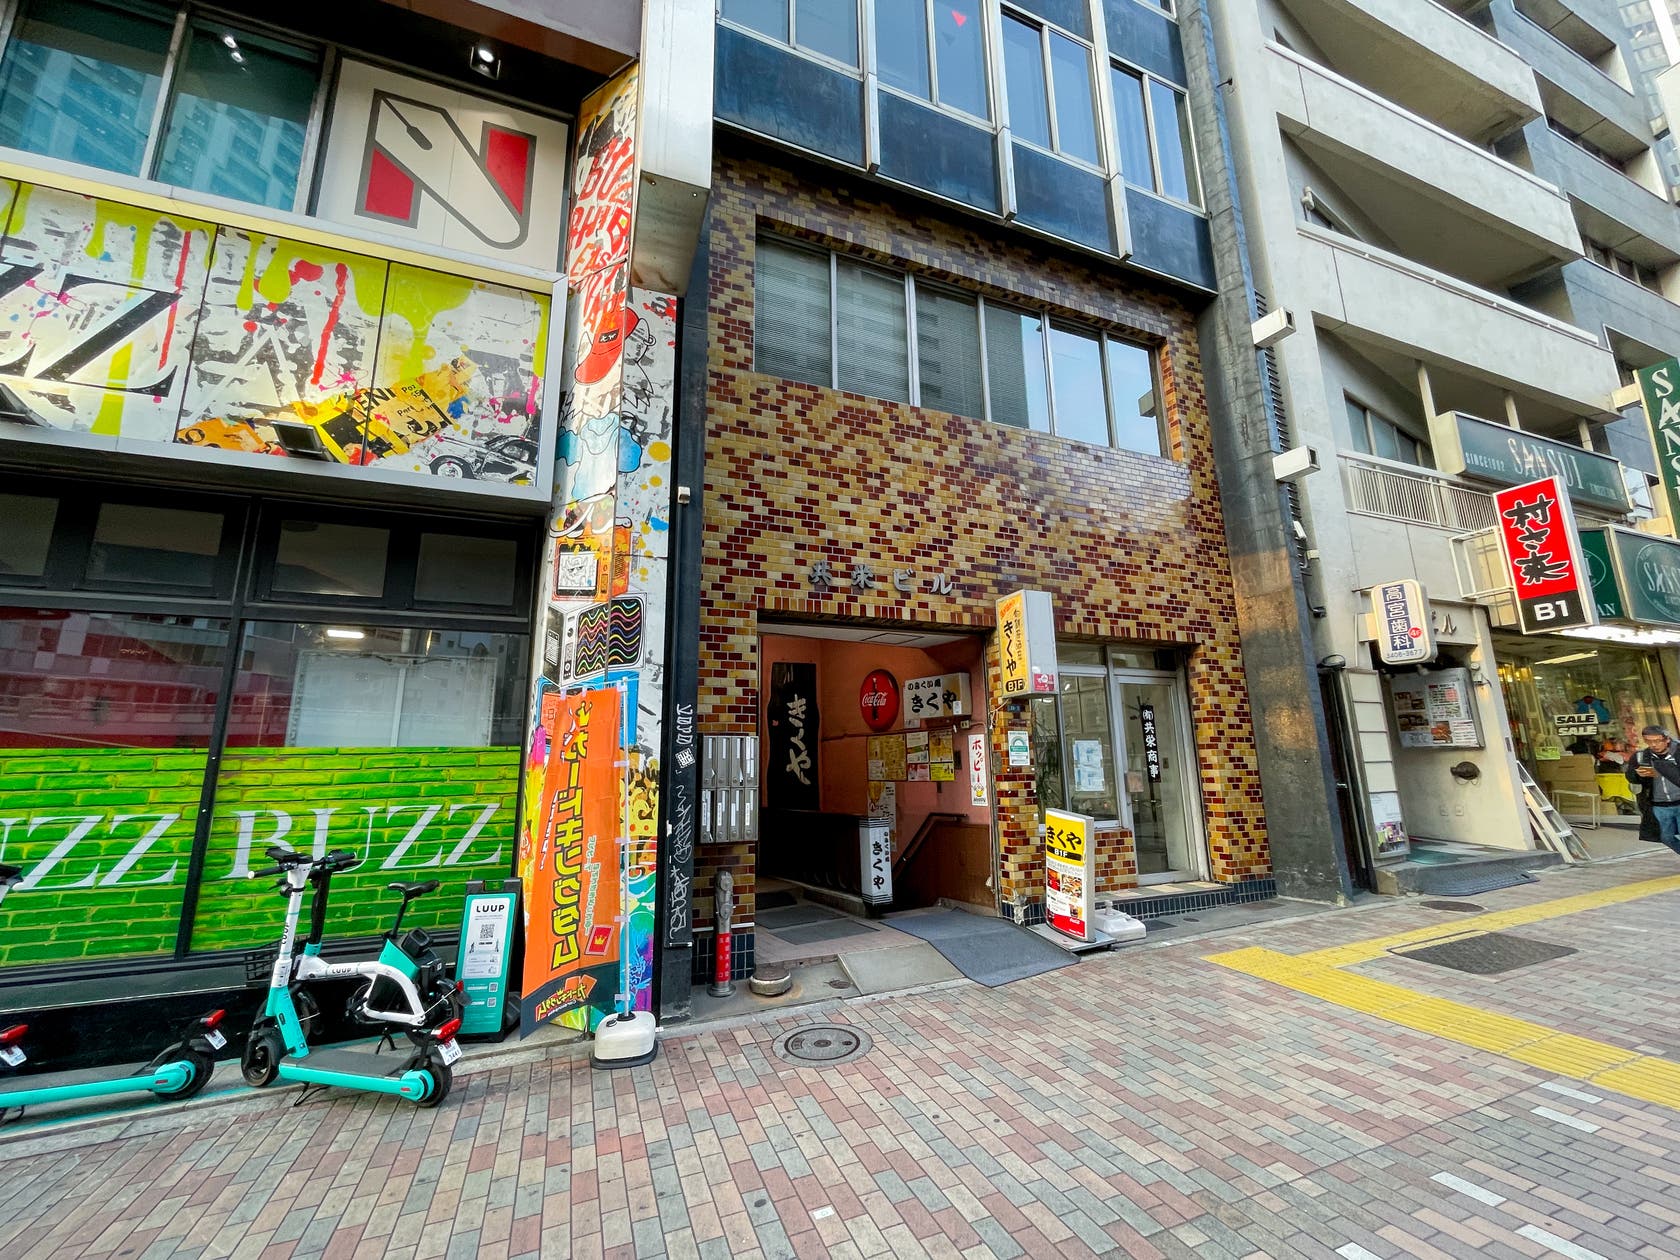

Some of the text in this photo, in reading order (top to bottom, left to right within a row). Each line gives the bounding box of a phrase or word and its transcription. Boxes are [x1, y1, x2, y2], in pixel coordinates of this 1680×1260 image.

[1507, 438, 1584, 490] SANSUI
[1503, 494, 1570, 585] 村さ来
[807, 560, 954, 595] 共栄ビル
[1385, 587, 1413, 650] 高宮歯科
[1534, 600, 1569, 621] B1
[1003, 620, 1016, 677] きくや
[911, 690, 957, 713] きくや
[1007, 681, 1024, 691] B1F
[1556, 714, 1596, 724] SALE
[1558, 727, 1598, 736] SALE
[786, 693, 811, 785] きくや
[972, 740, 984, 783] ホッピー
[221, 803, 502, 880] BUZZ
[1046, 825, 1082, 850] きくや
[1054, 848, 1068, 858] B1F
[873, 841, 884, 890] きくや
[476, 905, 505, 913] LUUP
